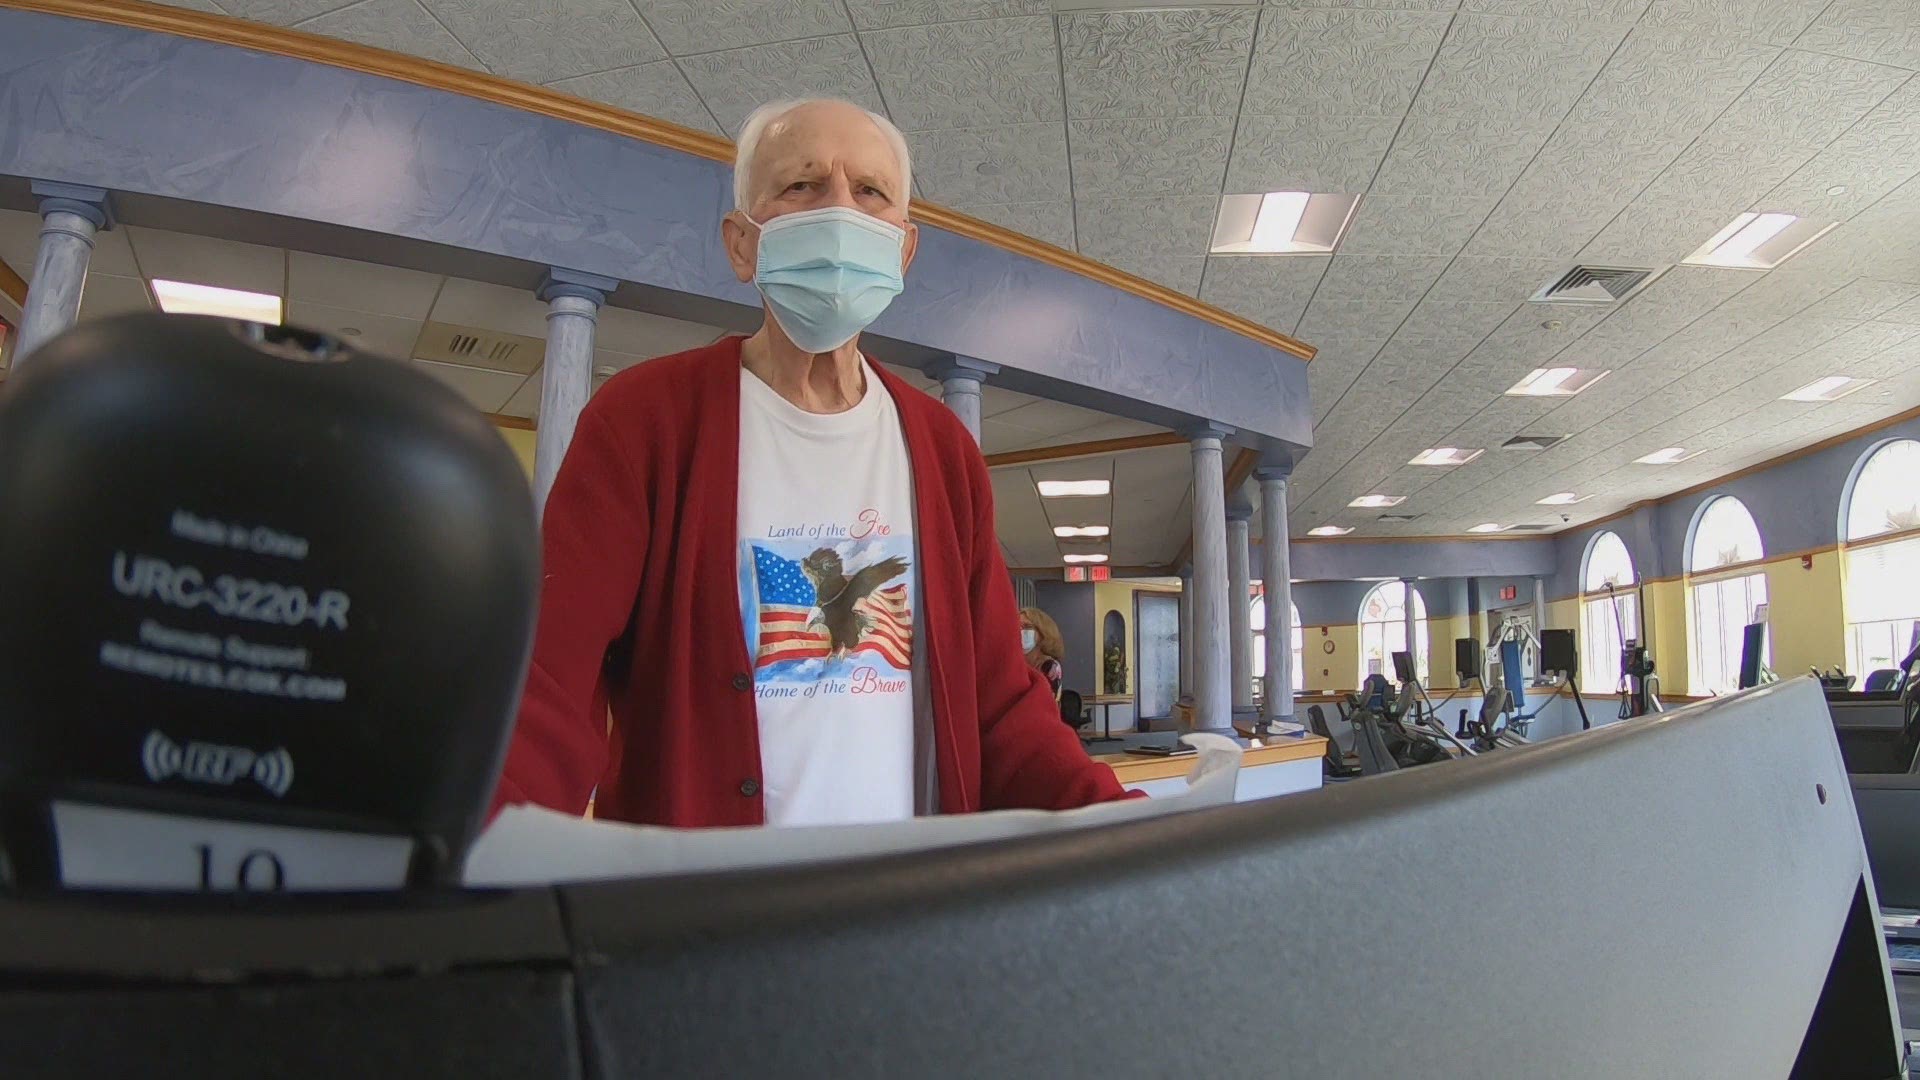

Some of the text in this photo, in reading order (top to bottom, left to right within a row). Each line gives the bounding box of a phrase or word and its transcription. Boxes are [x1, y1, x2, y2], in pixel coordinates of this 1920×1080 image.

[768, 523, 805, 538] Land
[808, 523, 824, 540] of
[826, 523, 846, 537] the
[112, 550, 351, 631] URC-3220-R
[755, 666, 906, 699] Home of the Brave
